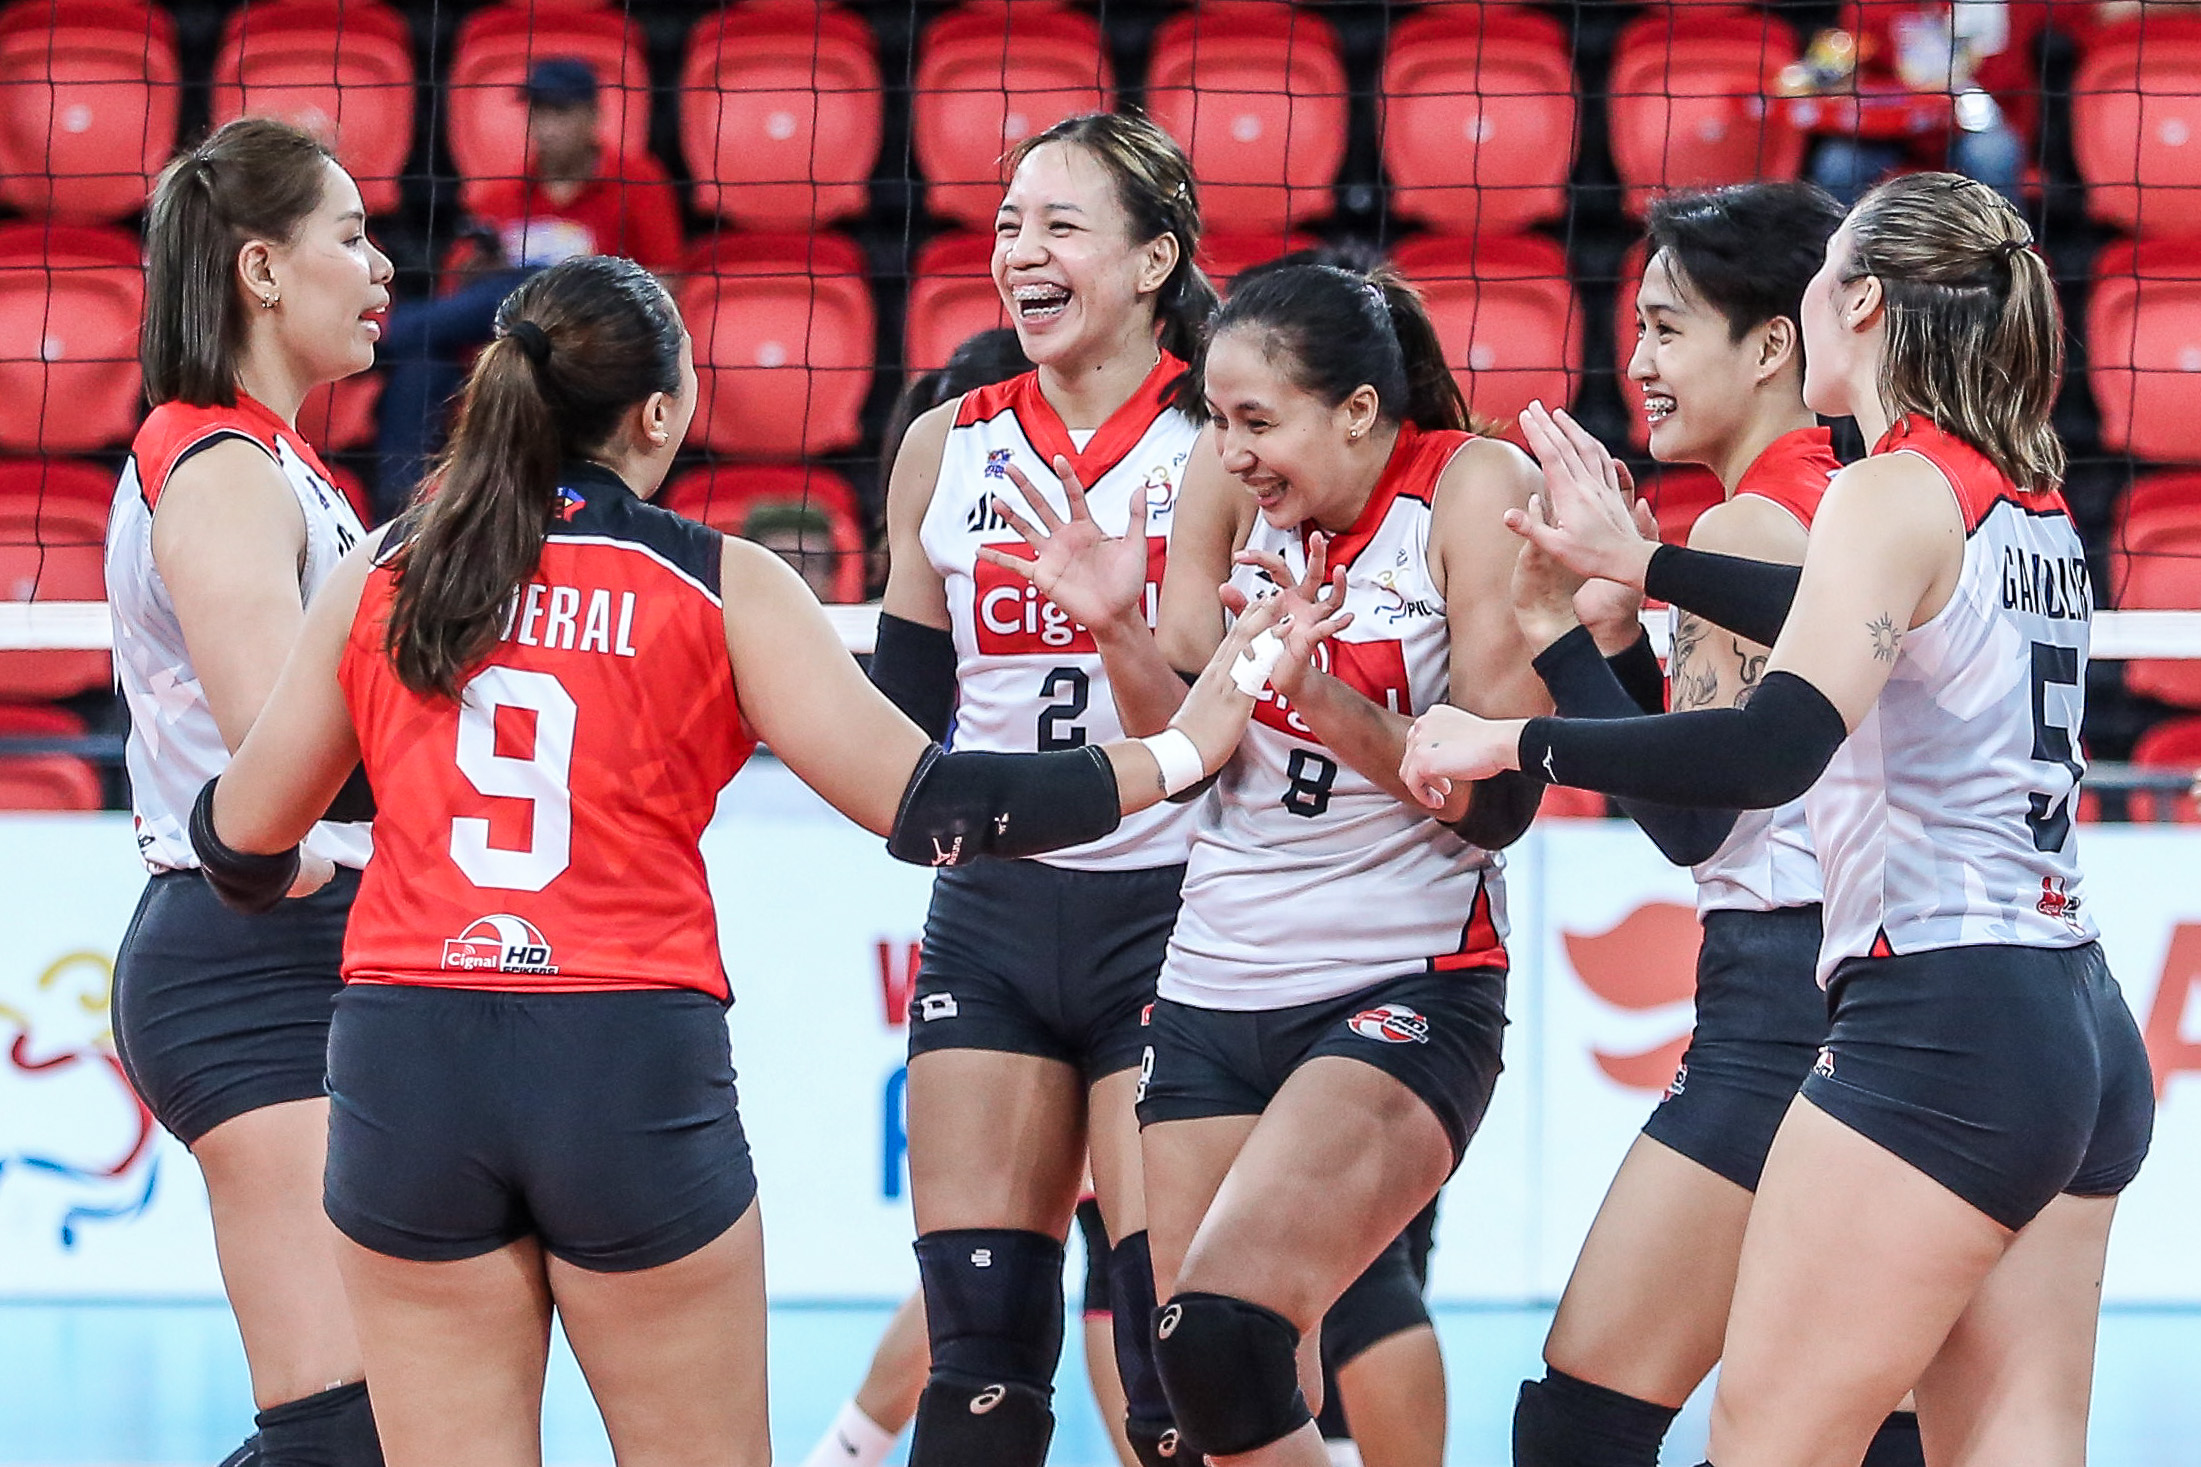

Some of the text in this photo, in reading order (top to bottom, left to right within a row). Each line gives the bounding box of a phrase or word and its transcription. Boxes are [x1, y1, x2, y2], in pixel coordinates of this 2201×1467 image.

[981, 581, 1158, 646] Cigl
[1038, 667, 1089, 752] 2
[2025, 641, 2084, 853] 5
[449, 665, 578, 893] 9
[1281, 748, 1338, 818] 8
[447, 946, 548, 970] Cignal HD
